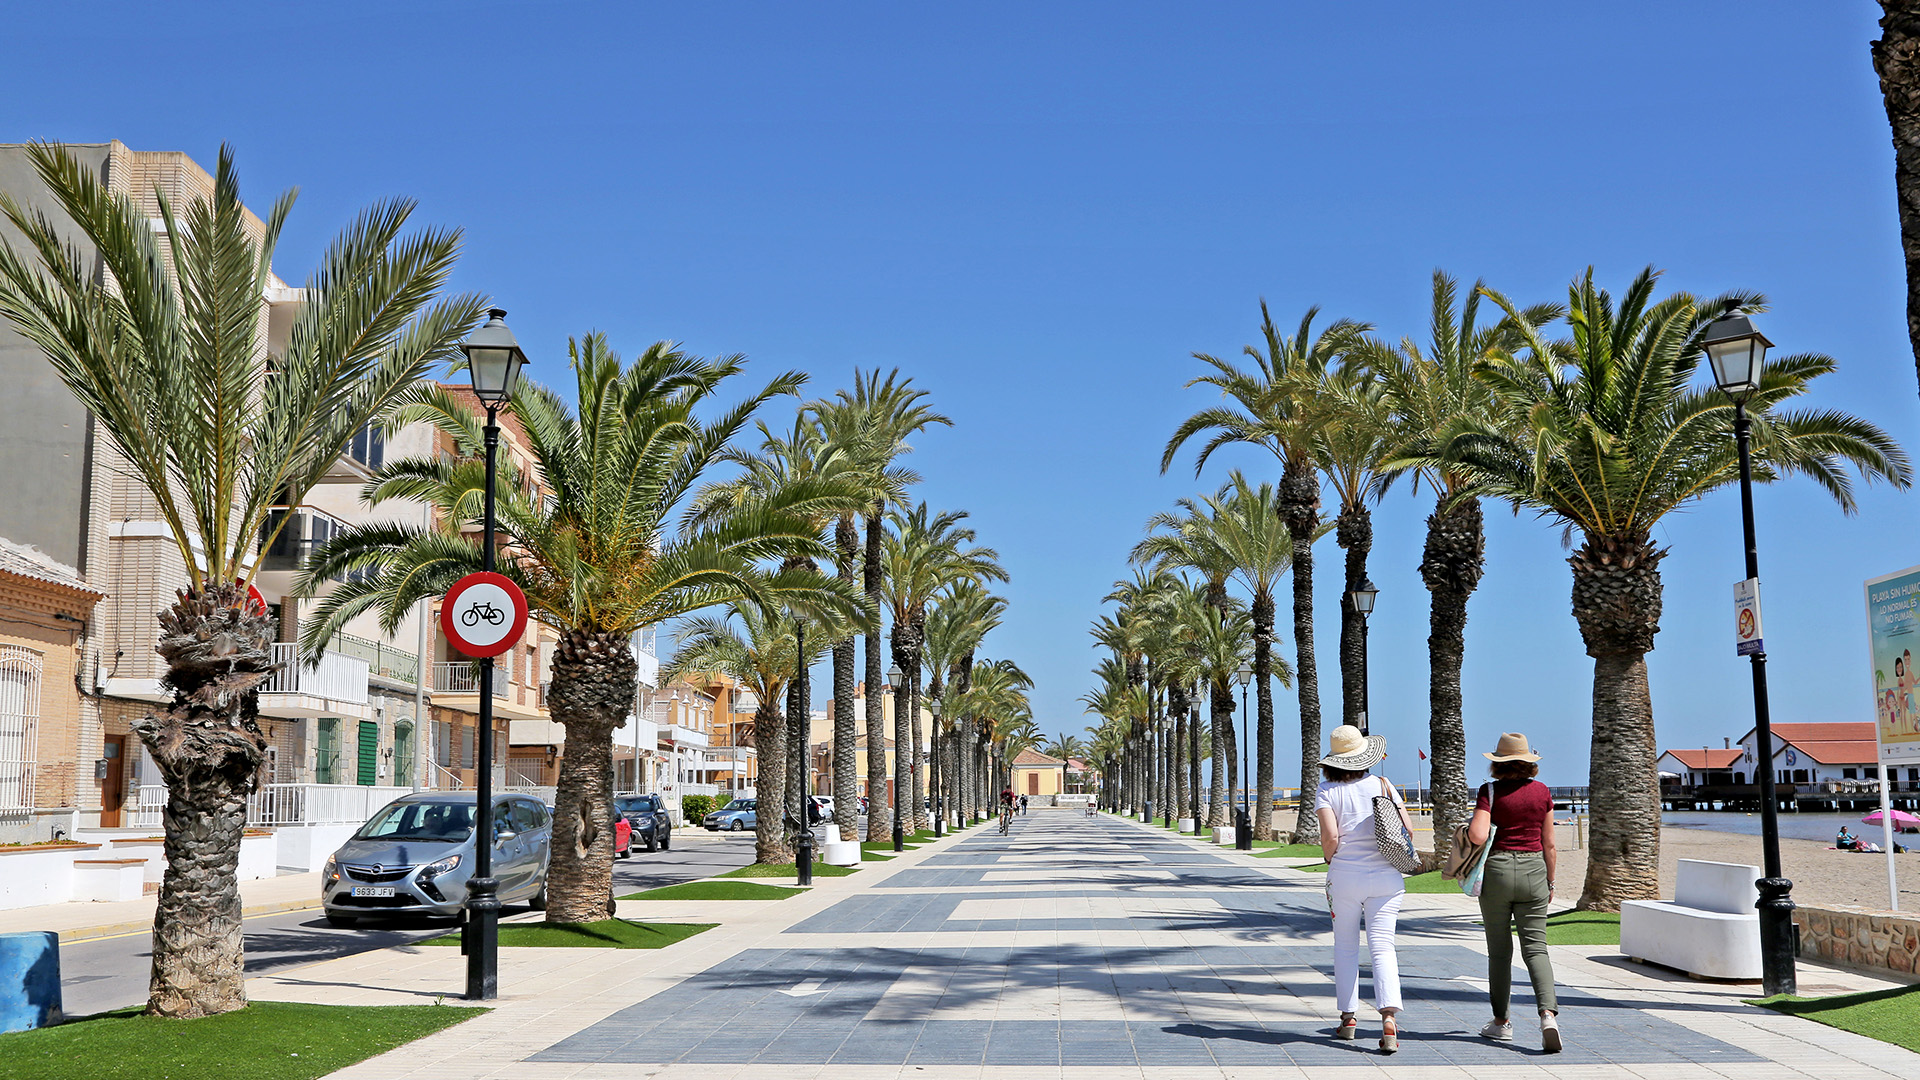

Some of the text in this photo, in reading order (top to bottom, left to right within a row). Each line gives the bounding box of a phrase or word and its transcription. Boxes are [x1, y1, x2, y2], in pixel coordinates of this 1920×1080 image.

[1872, 590, 1890, 603] PLAYA
[1891, 587, 1901, 599] SIN
[1880, 598, 1917, 615] LO NORMAL ES
[1885, 614, 1894, 624] NO
[356, 888, 394, 896] 9633 JFV
